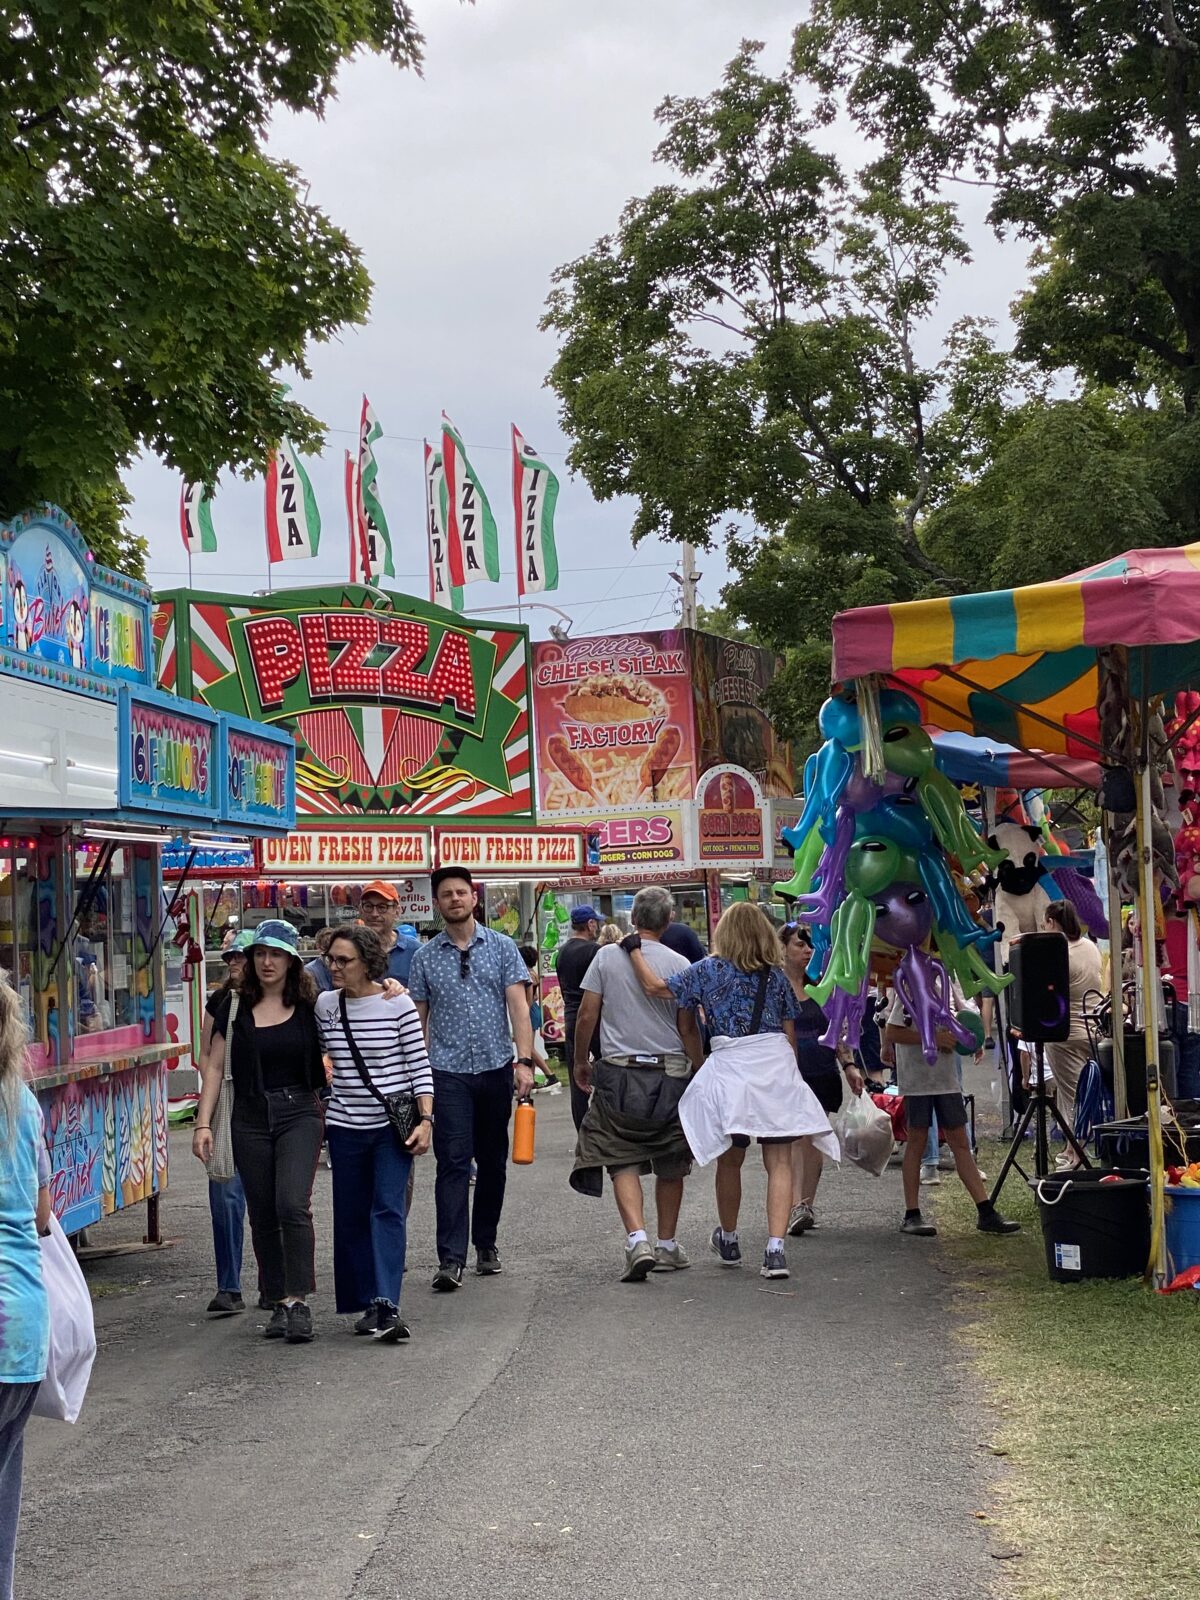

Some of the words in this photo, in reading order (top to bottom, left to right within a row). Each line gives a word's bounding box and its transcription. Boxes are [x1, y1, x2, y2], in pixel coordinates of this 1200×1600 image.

[279, 453, 304, 546] ZZA
[463, 472, 480, 570] ZZA
[95, 605, 110, 662] ICE
[564, 638, 654, 662] Philly
[244, 613, 475, 724] PIZZA
[537, 658, 614, 684] CHEESE
[617, 652, 686, 676] STEAK
[562, 717, 664, 749] FACTORY
[149, 736, 208, 796] FLAVORS
[586, 815, 673, 848] GERS
[702, 813, 730, 837] CORN
[731, 813, 761, 836] DOGS
[266, 836, 313, 863] OVEN
[318, 836, 373, 863] FRESH
[378, 836, 424, 863] PIZZA
[441, 837, 481, 862] OVEN
[486, 837, 534, 862] FRESH
[537, 837, 577, 862] PIZZA
[599, 853, 626, 863] URGERS
[632, 851, 653, 860] CORN
[653, 849, 674, 858] DOGS
[404, 880, 414, 893] 3
[546, 874, 617, 888] CHEESE
[619, 870, 692, 884] STEAKS
[410, 903, 430, 913] Cup
